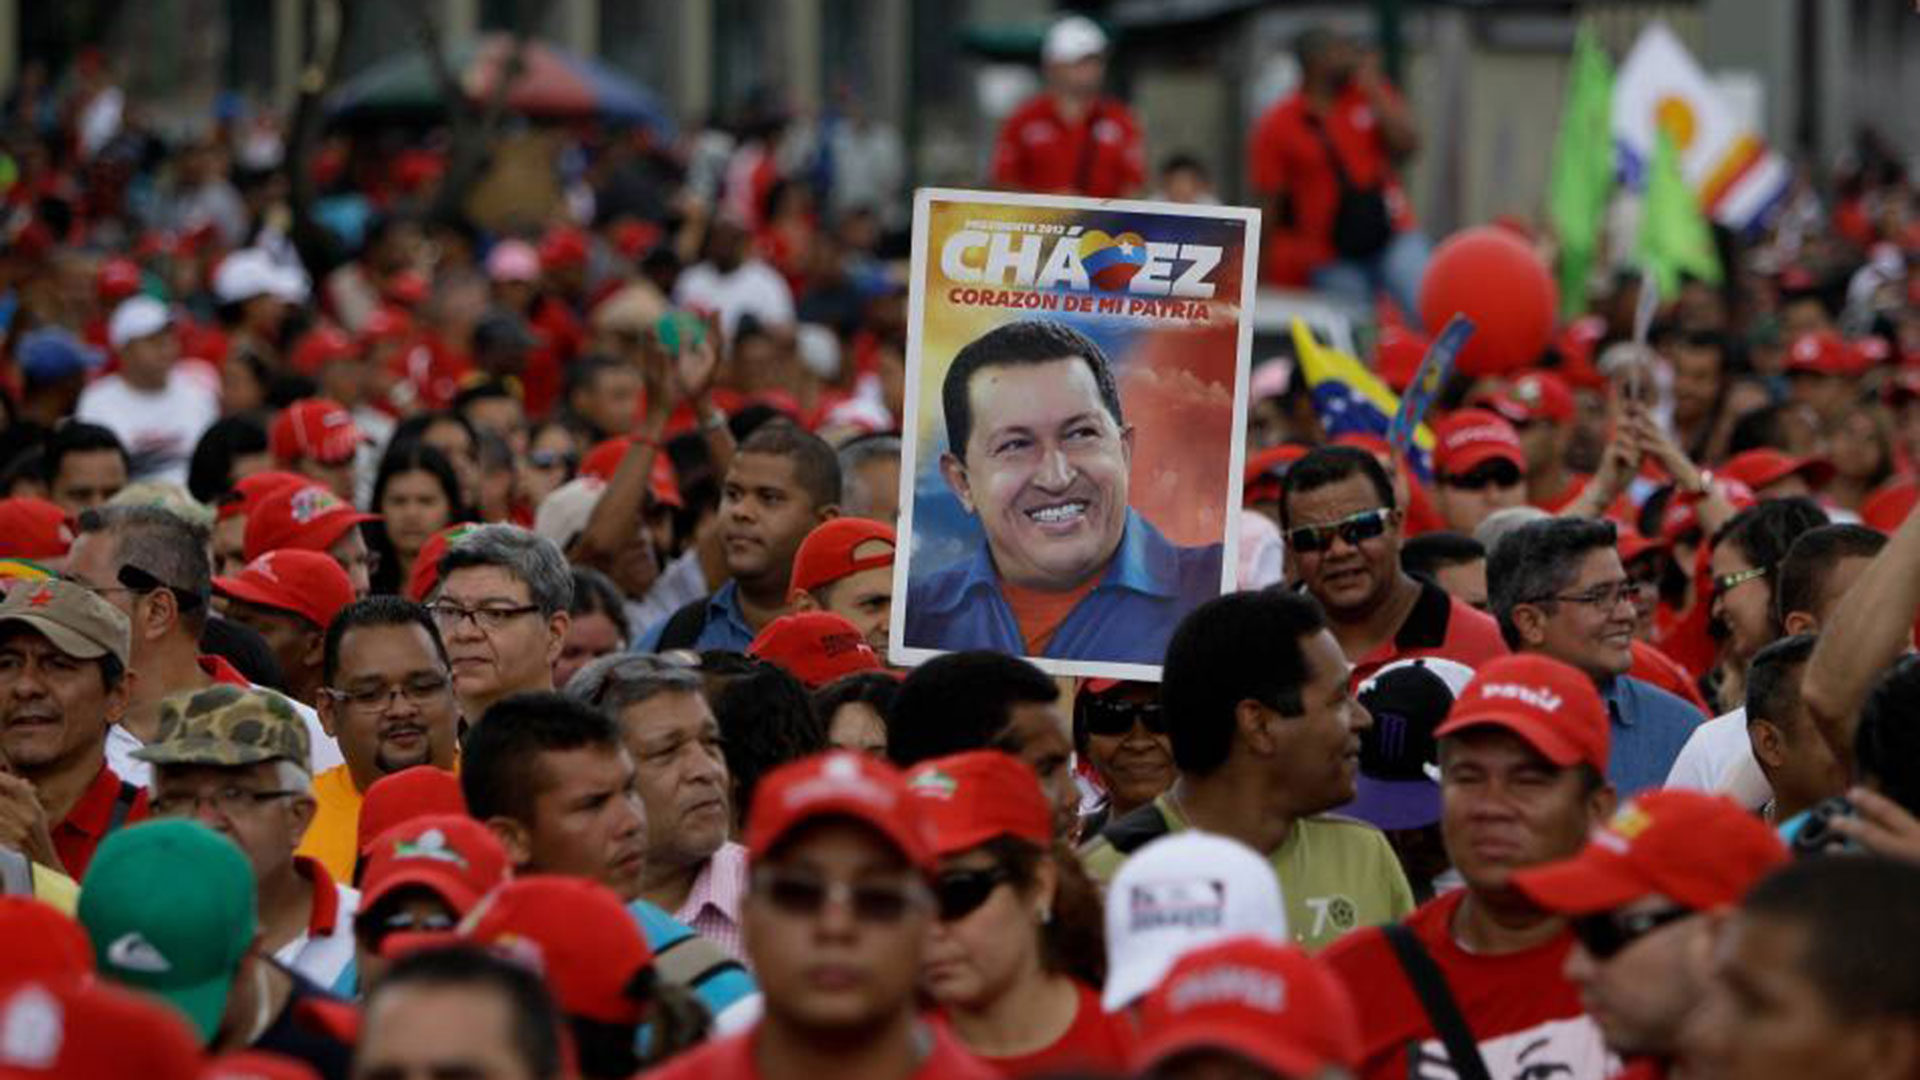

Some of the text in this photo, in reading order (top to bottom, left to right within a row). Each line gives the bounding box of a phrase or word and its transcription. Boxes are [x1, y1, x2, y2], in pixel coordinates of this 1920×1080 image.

[1064, 295, 1093, 312] DE
[1098, 297, 1124, 315] MI
[1128, 299, 1210, 319] PATRIA
